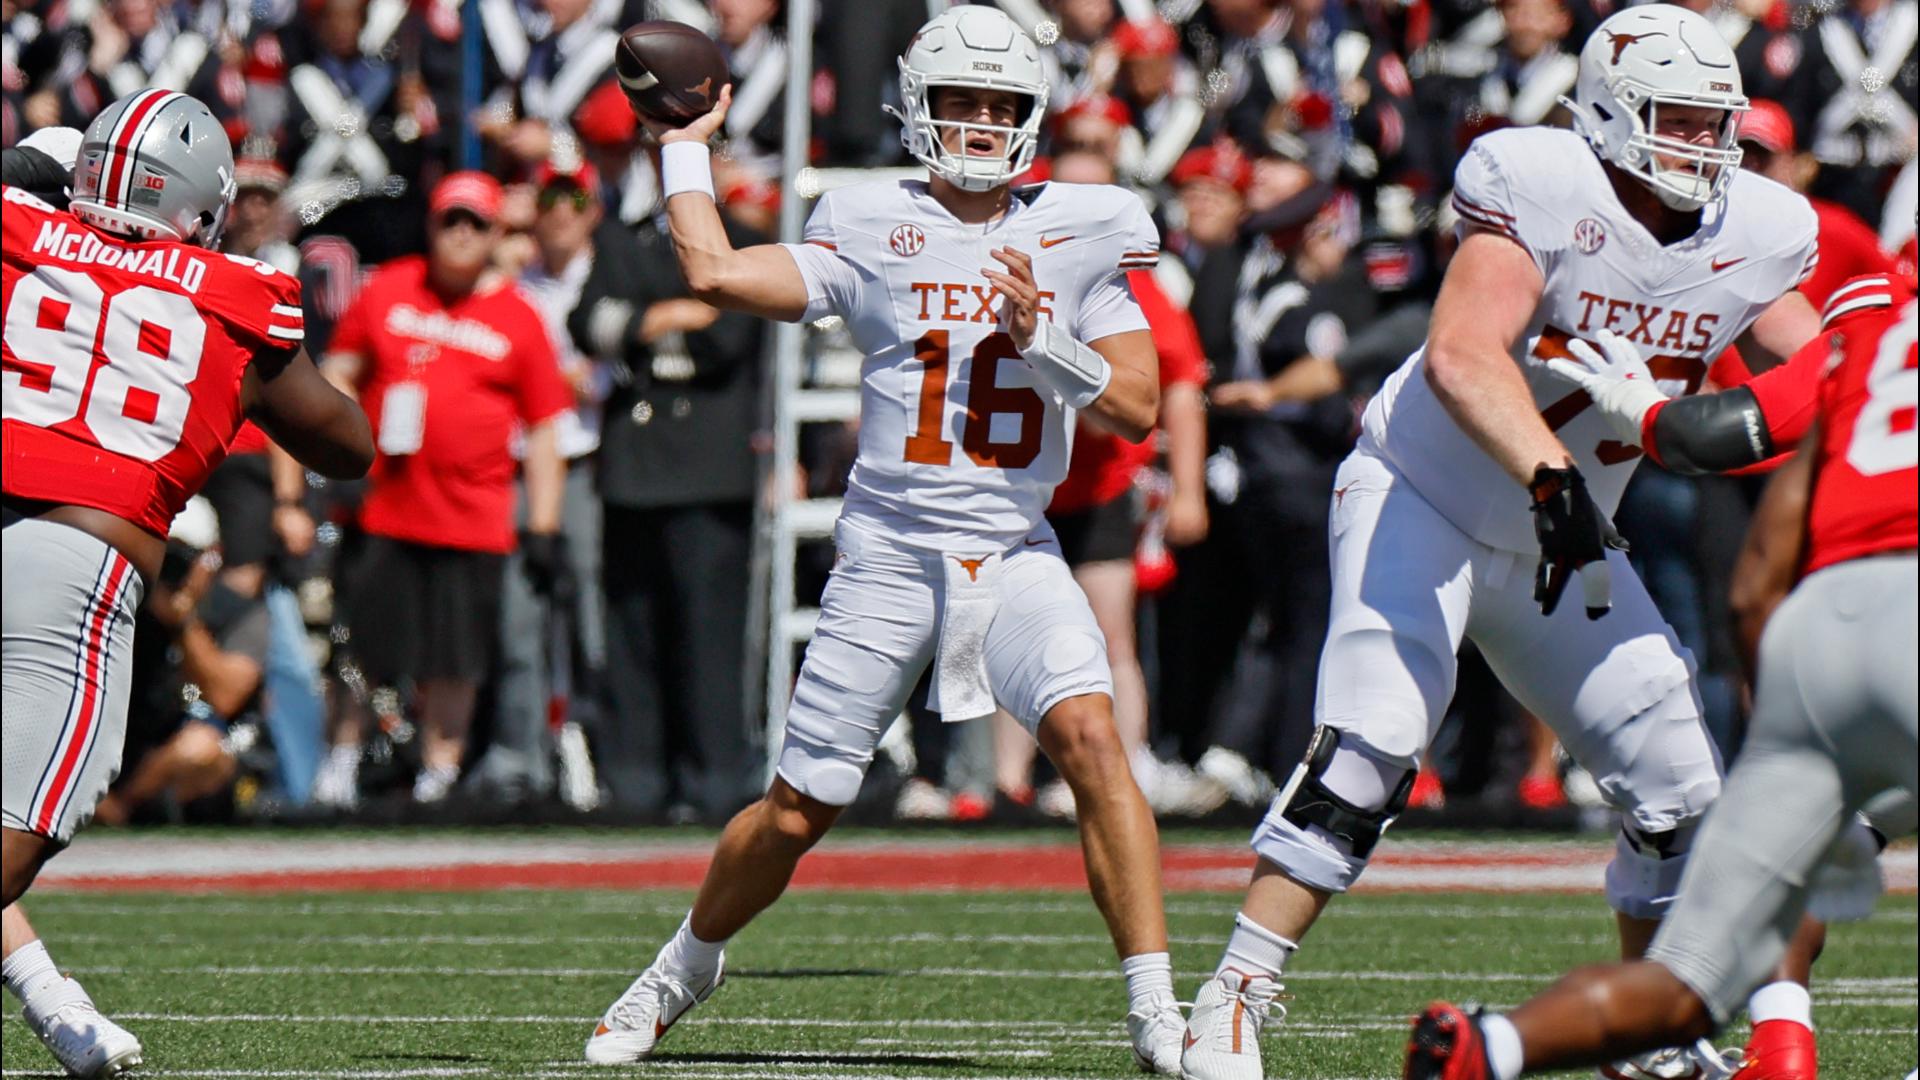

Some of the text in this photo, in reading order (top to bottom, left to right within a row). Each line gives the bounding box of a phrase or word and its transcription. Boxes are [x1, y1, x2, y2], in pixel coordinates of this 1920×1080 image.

[889, 224, 925, 257] SEC
[2, 264, 207, 462] 98
[1577, 291, 1720, 352] TEXAS
[904, 329, 1045, 469] 16
